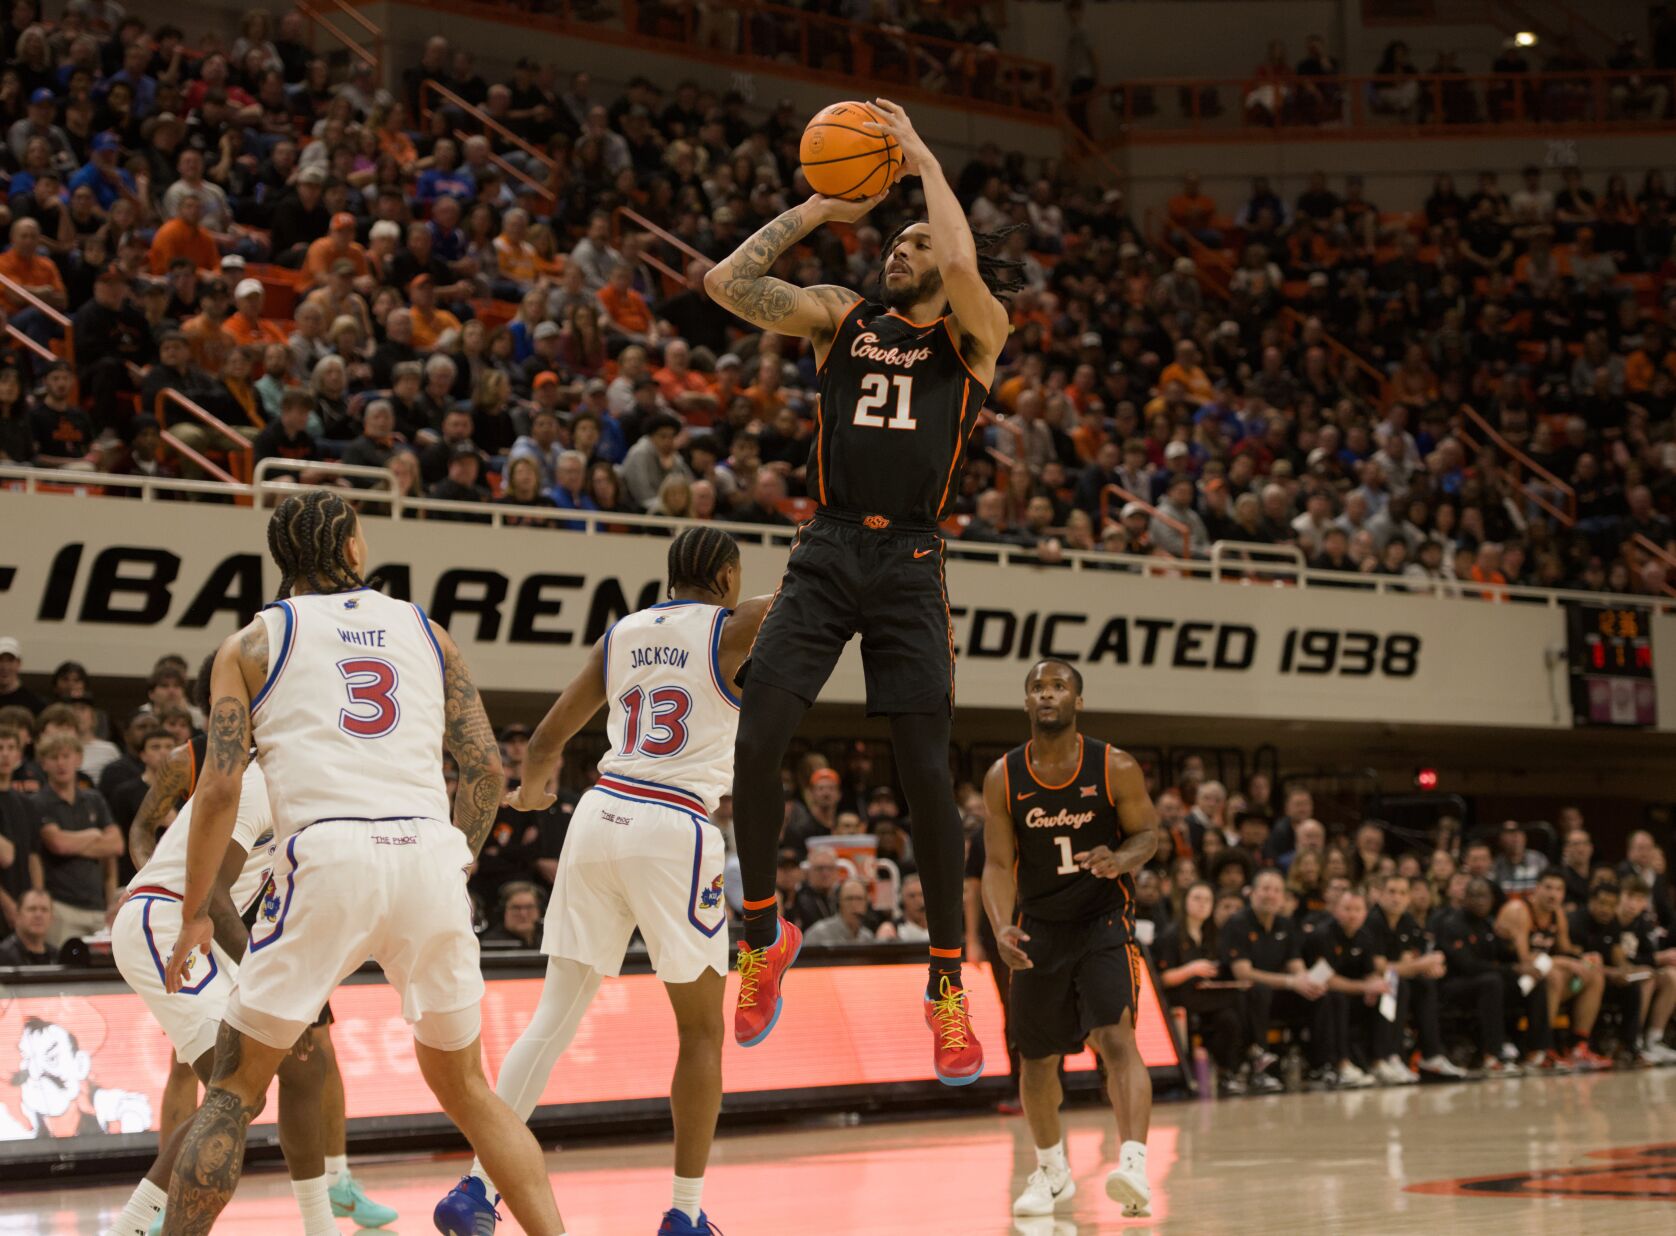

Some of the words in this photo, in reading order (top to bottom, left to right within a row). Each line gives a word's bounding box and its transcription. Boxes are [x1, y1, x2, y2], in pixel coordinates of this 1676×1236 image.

[850, 331, 933, 369] Cowboys
[852, 372, 917, 430] 21
[336, 628, 387, 648] WHITE
[631, 646, 689, 669] JACKSON
[1278, 627, 1422, 678] 1938
[335, 656, 401, 740] 3
[617, 684, 693, 759] 13
[1025, 807, 1096, 830] Cowboys
[1053, 836, 1080, 875] 1
